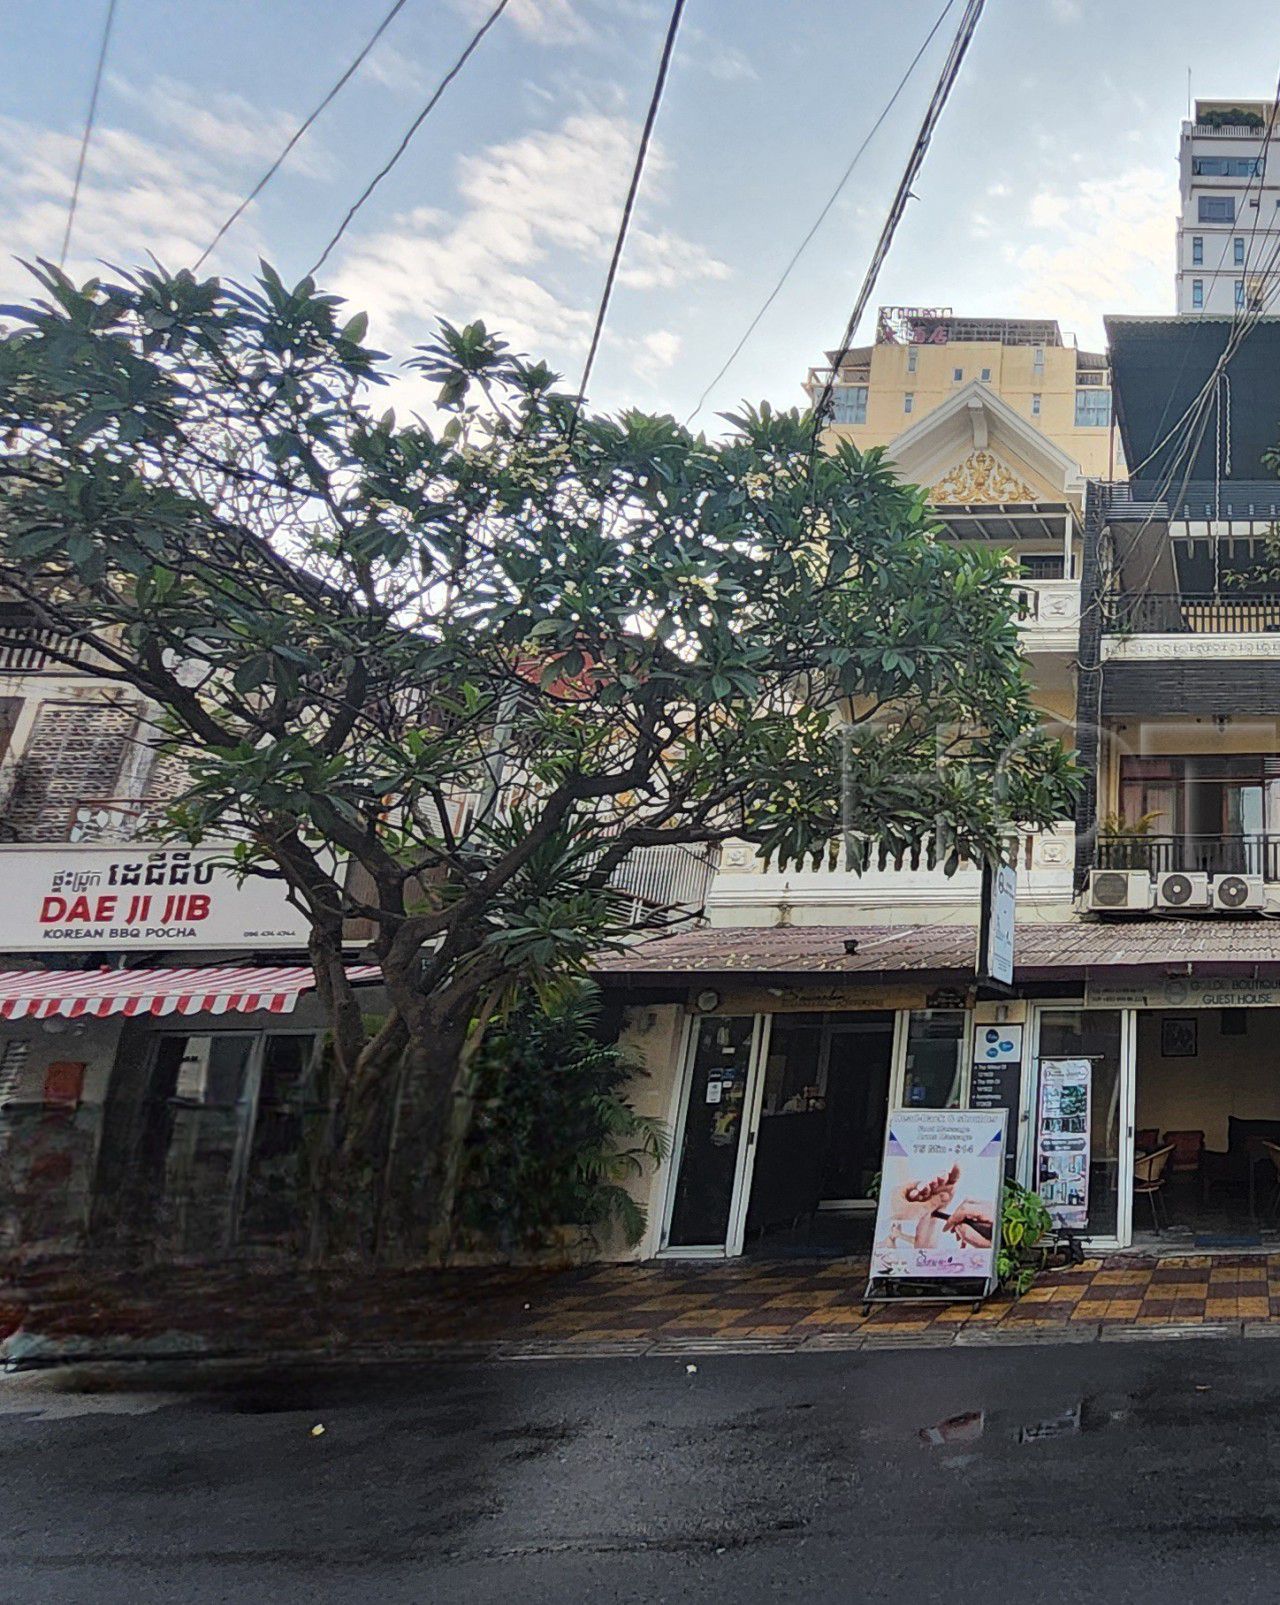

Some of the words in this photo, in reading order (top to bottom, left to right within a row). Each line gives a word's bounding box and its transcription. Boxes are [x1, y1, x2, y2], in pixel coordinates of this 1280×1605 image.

[39, 896, 117, 923] DAE
[125, 896, 153, 925] JI
[161, 894, 212, 925] JIB
[43, 928, 103, 939] KOREAN
[109, 928, 140, 938] BBQ
[145, 927, 197, 938] POCHA
[1202, 994, 1235, 1005] GUEST
[1238, 993, 1272, 1004] HOUSE
